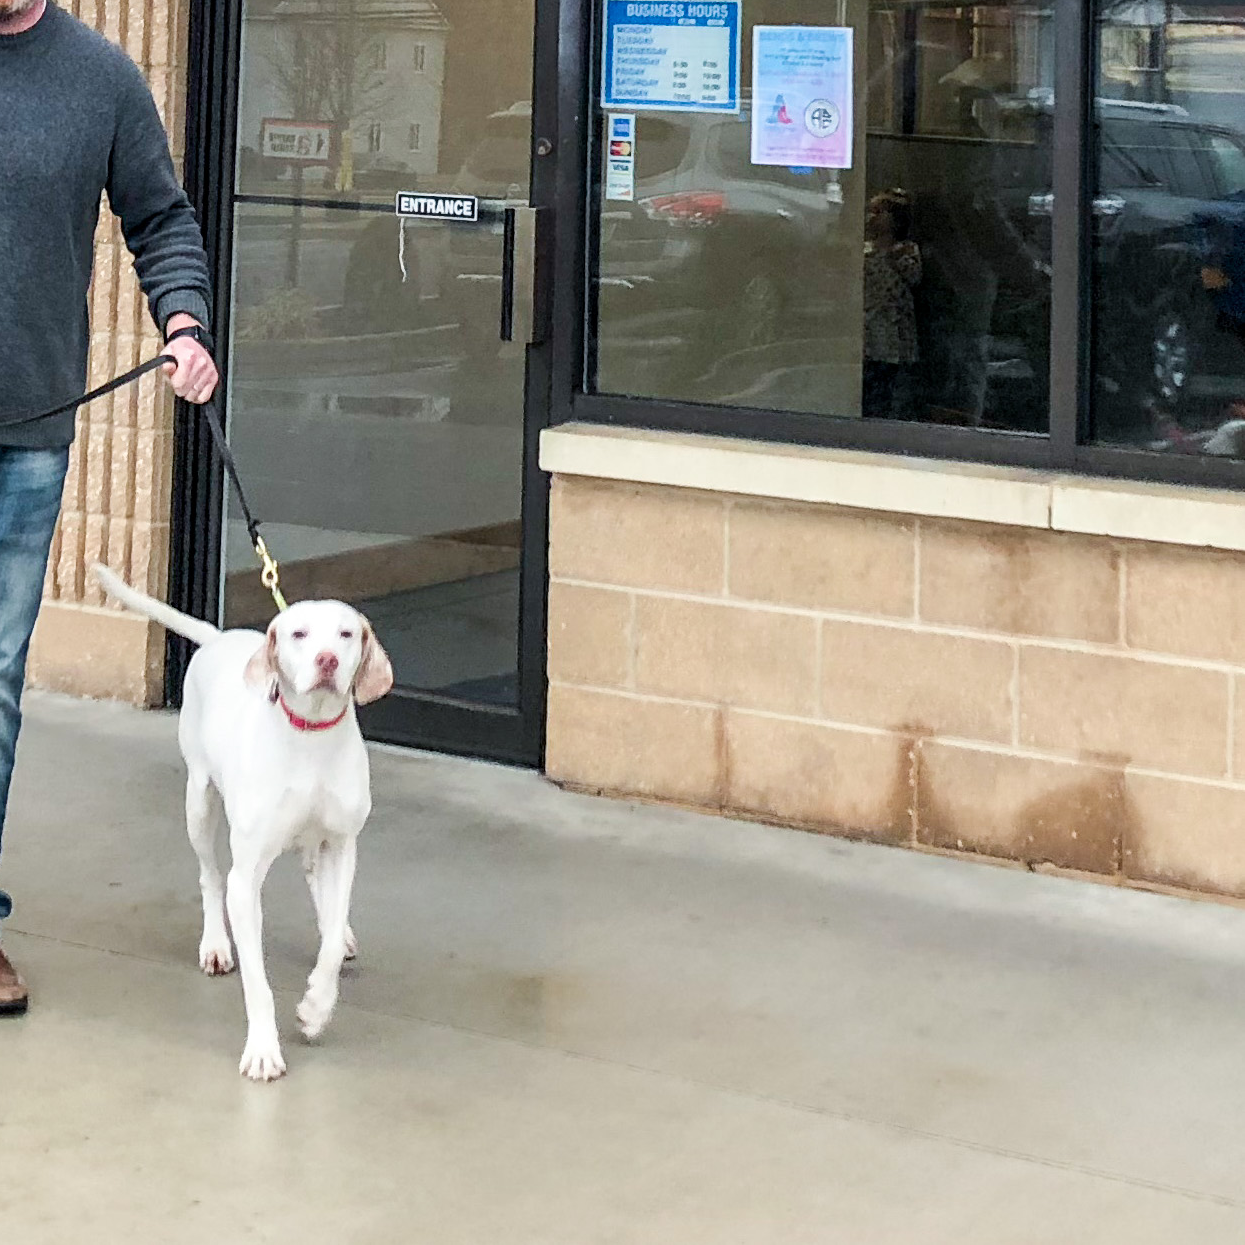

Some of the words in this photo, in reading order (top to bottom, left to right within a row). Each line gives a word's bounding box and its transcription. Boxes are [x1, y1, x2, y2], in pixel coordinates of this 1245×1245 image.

[626, 3, 685, 17] BUSINESS
[687, 4, 729, 18] HOURS
[400, 196, 473, 217] ENTRANCE
